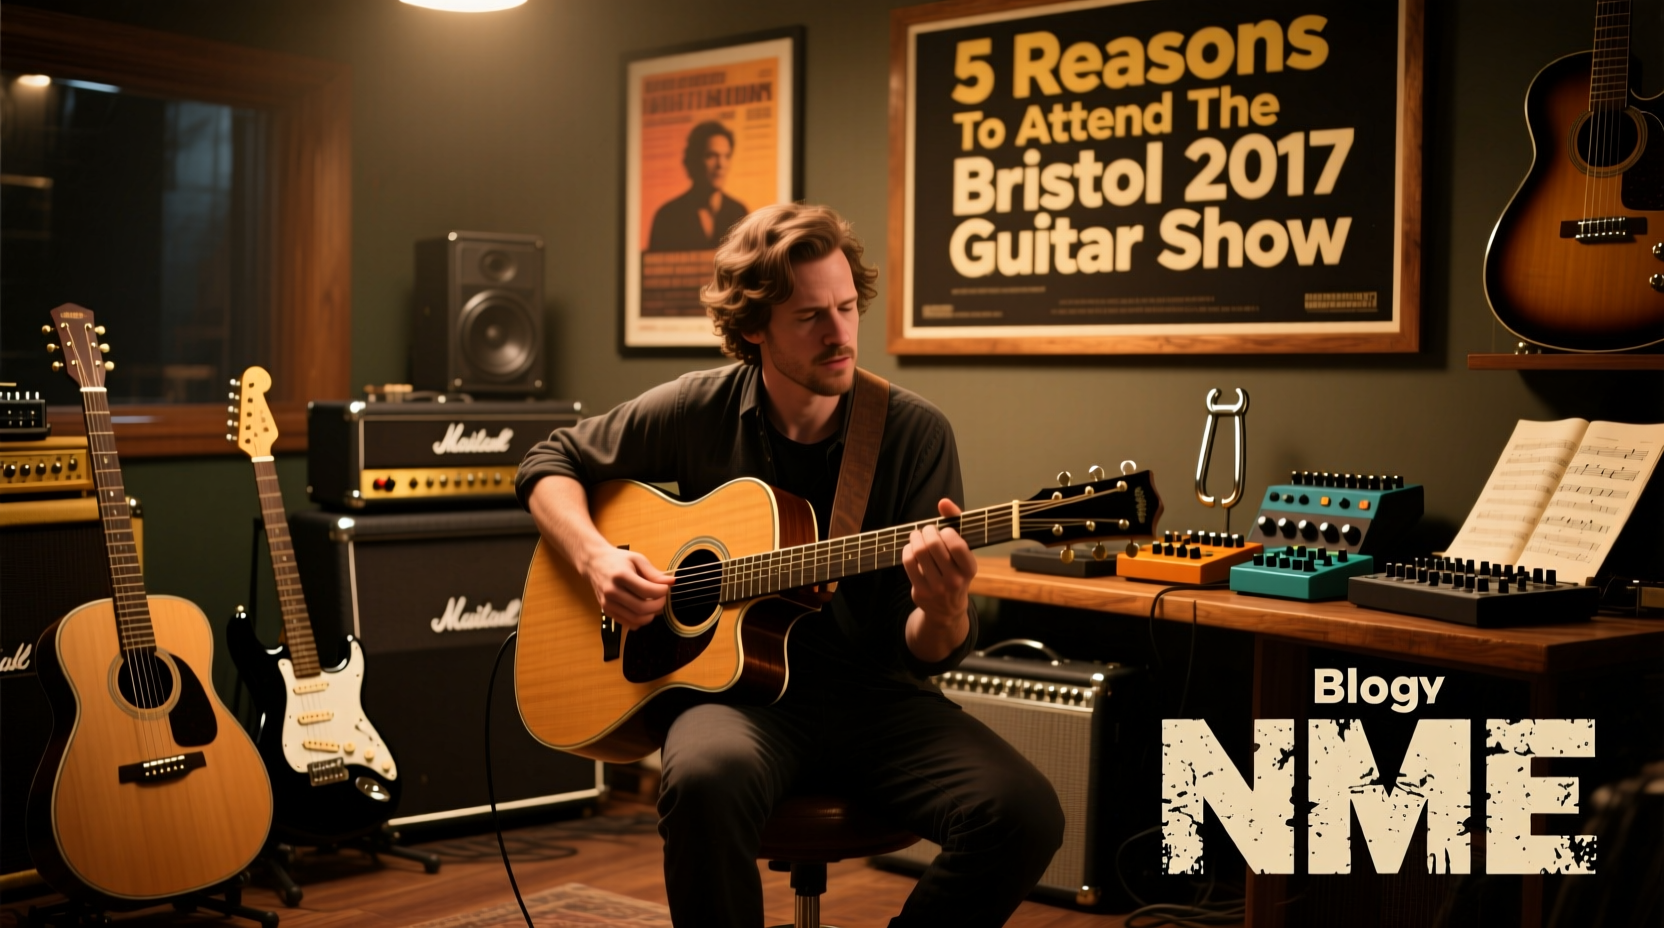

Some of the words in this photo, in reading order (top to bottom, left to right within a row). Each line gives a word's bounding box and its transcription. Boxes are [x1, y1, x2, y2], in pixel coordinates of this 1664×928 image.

[951, 38, 995, 105] 5
[1012, 15, 1329, 99] Reasons
[953, 110, 1006, 151] To
[1015, 91, 1173, 147] Attend
[1187, 85, 1280, 131] The
[952, 141, 1163, 216] Bristol
[1184, 128, 1355, 203] 2017
[949, 211, 1144, 279] Guitar
[1157, 206, 1353, 271] Show
